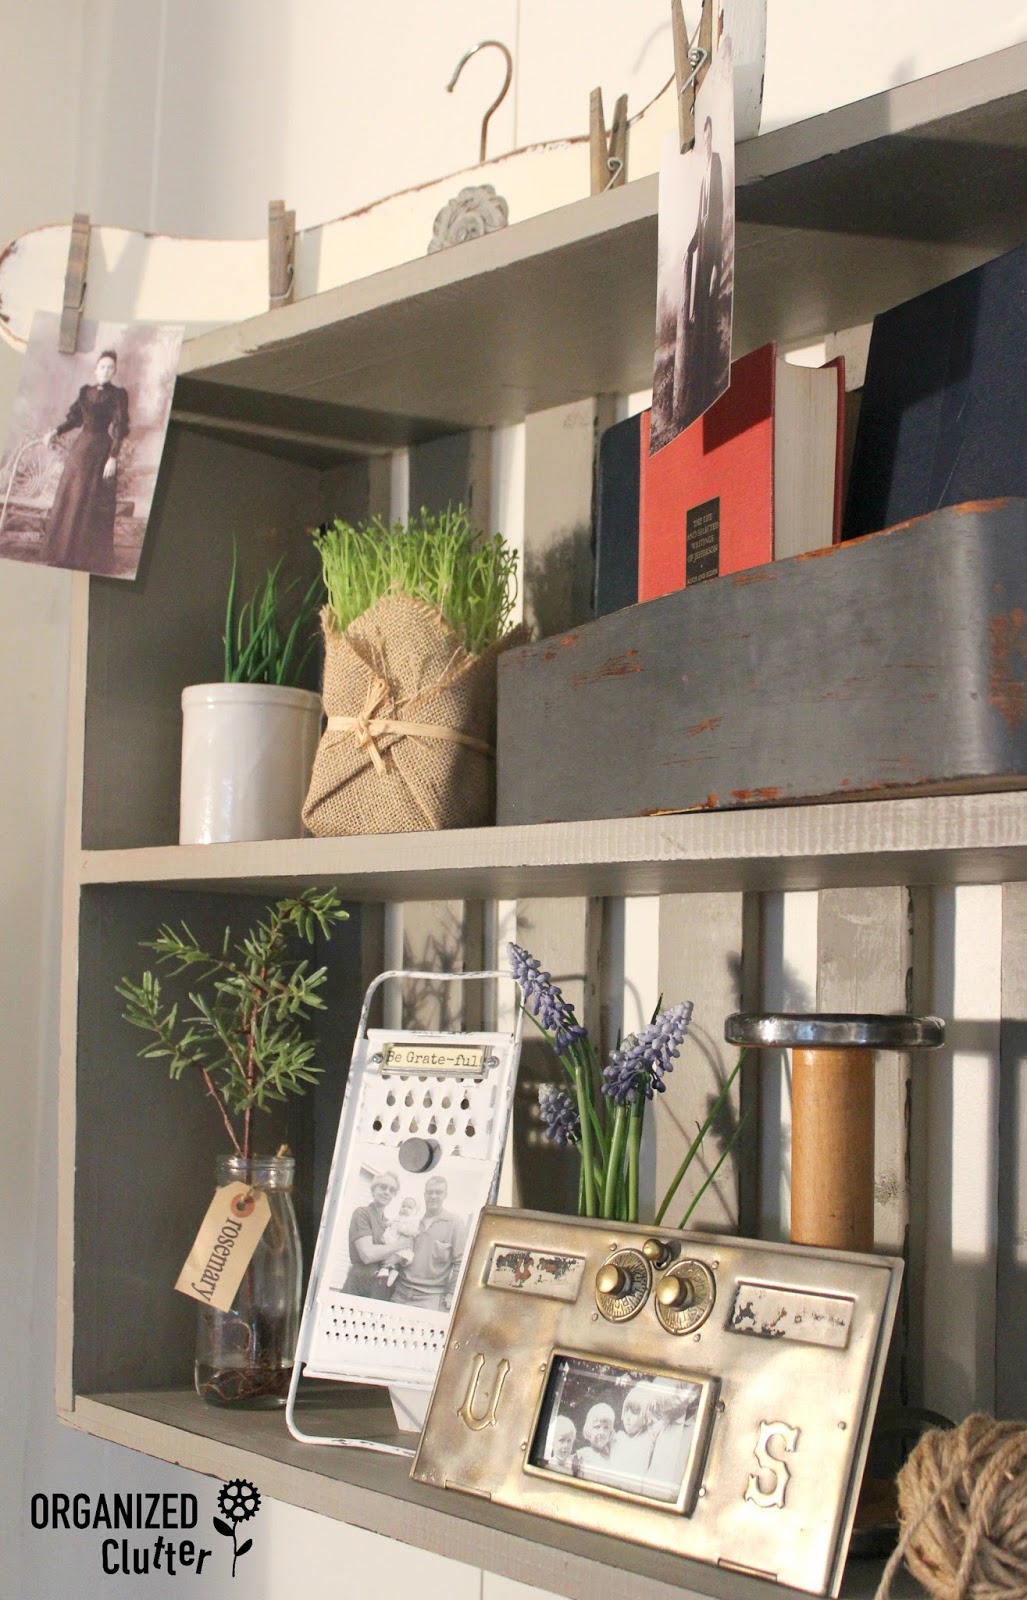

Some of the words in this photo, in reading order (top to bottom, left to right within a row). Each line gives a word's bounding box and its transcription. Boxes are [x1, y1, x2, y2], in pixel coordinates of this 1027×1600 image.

[693, 517, 703, 528] THE
[387, 1050, 403, 1063] Be
[191, 1217, 243, 1302] rosemary
[743, 1419, 801, 1509] S
